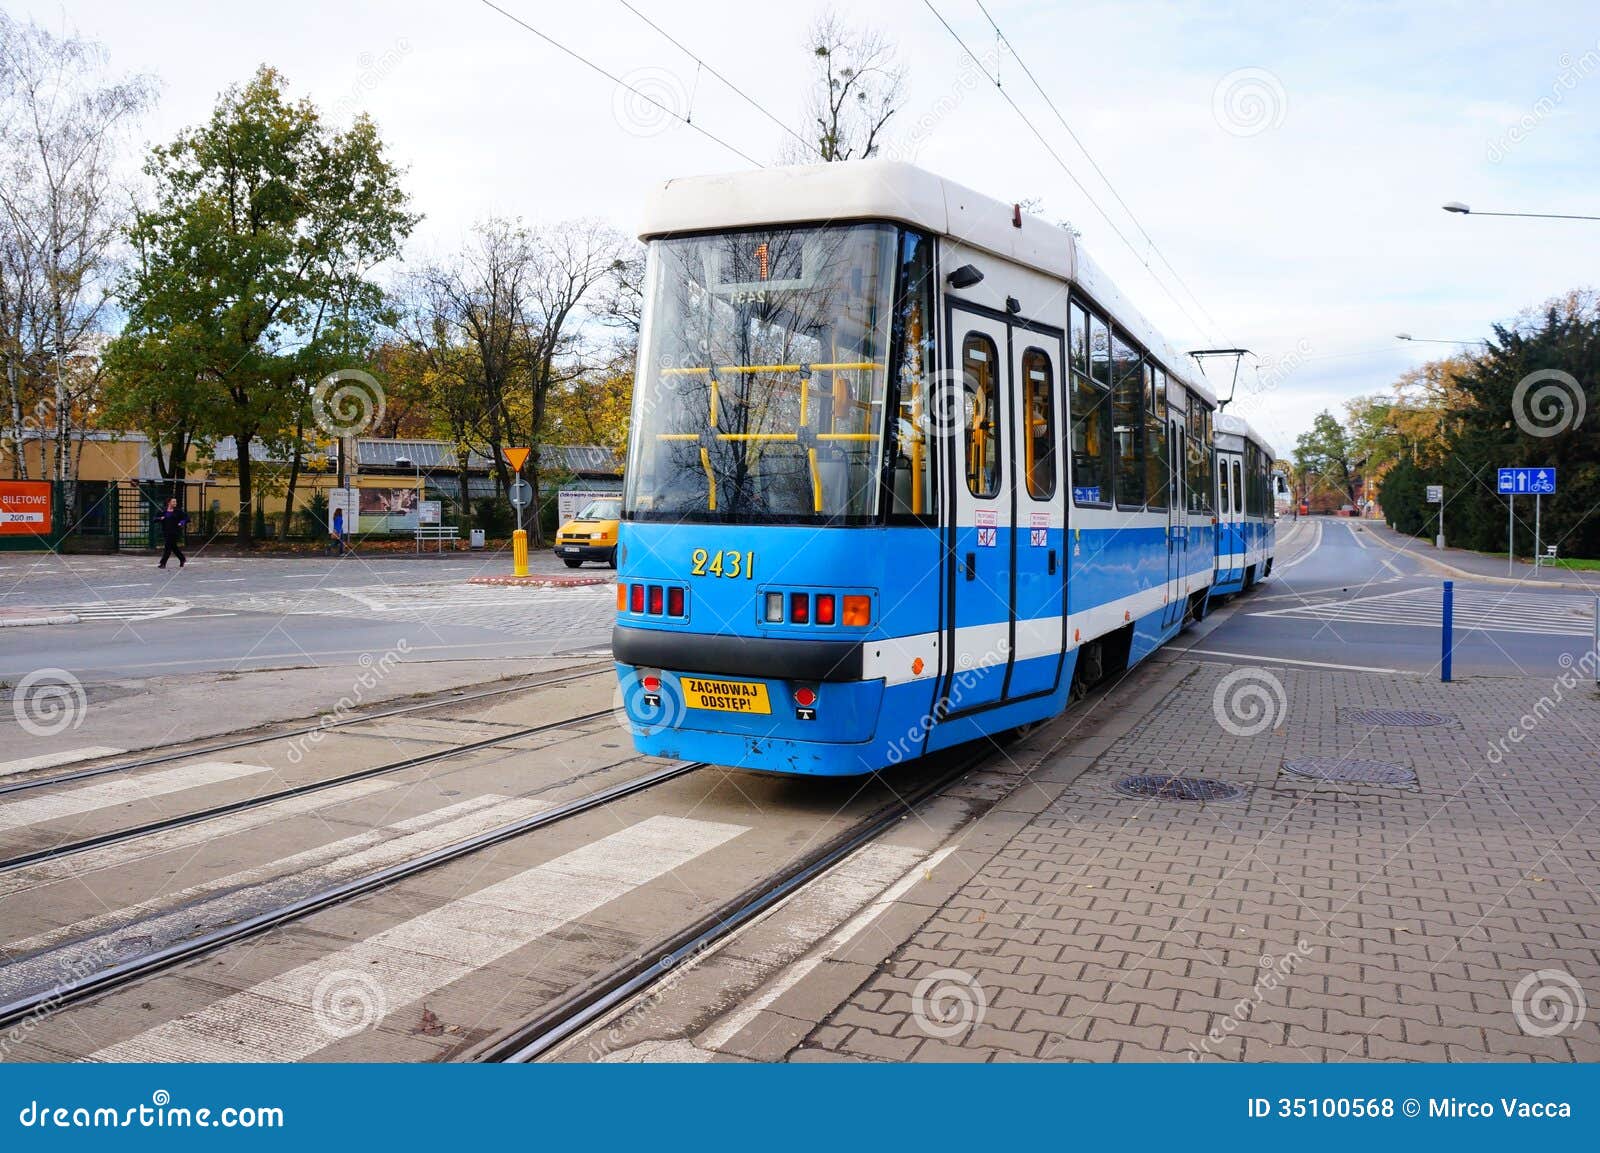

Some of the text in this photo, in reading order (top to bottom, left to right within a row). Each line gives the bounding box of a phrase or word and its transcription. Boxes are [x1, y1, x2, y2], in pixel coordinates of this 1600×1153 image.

[754, 243, 768, 280] 1
[2, 496, 47, 504] BILETOWE
[691, 549, 754, 579] 2431
[690, 681, 757, 696] ZACHOWAJ
[701, 695, 751, 711] ODSTĘP!
